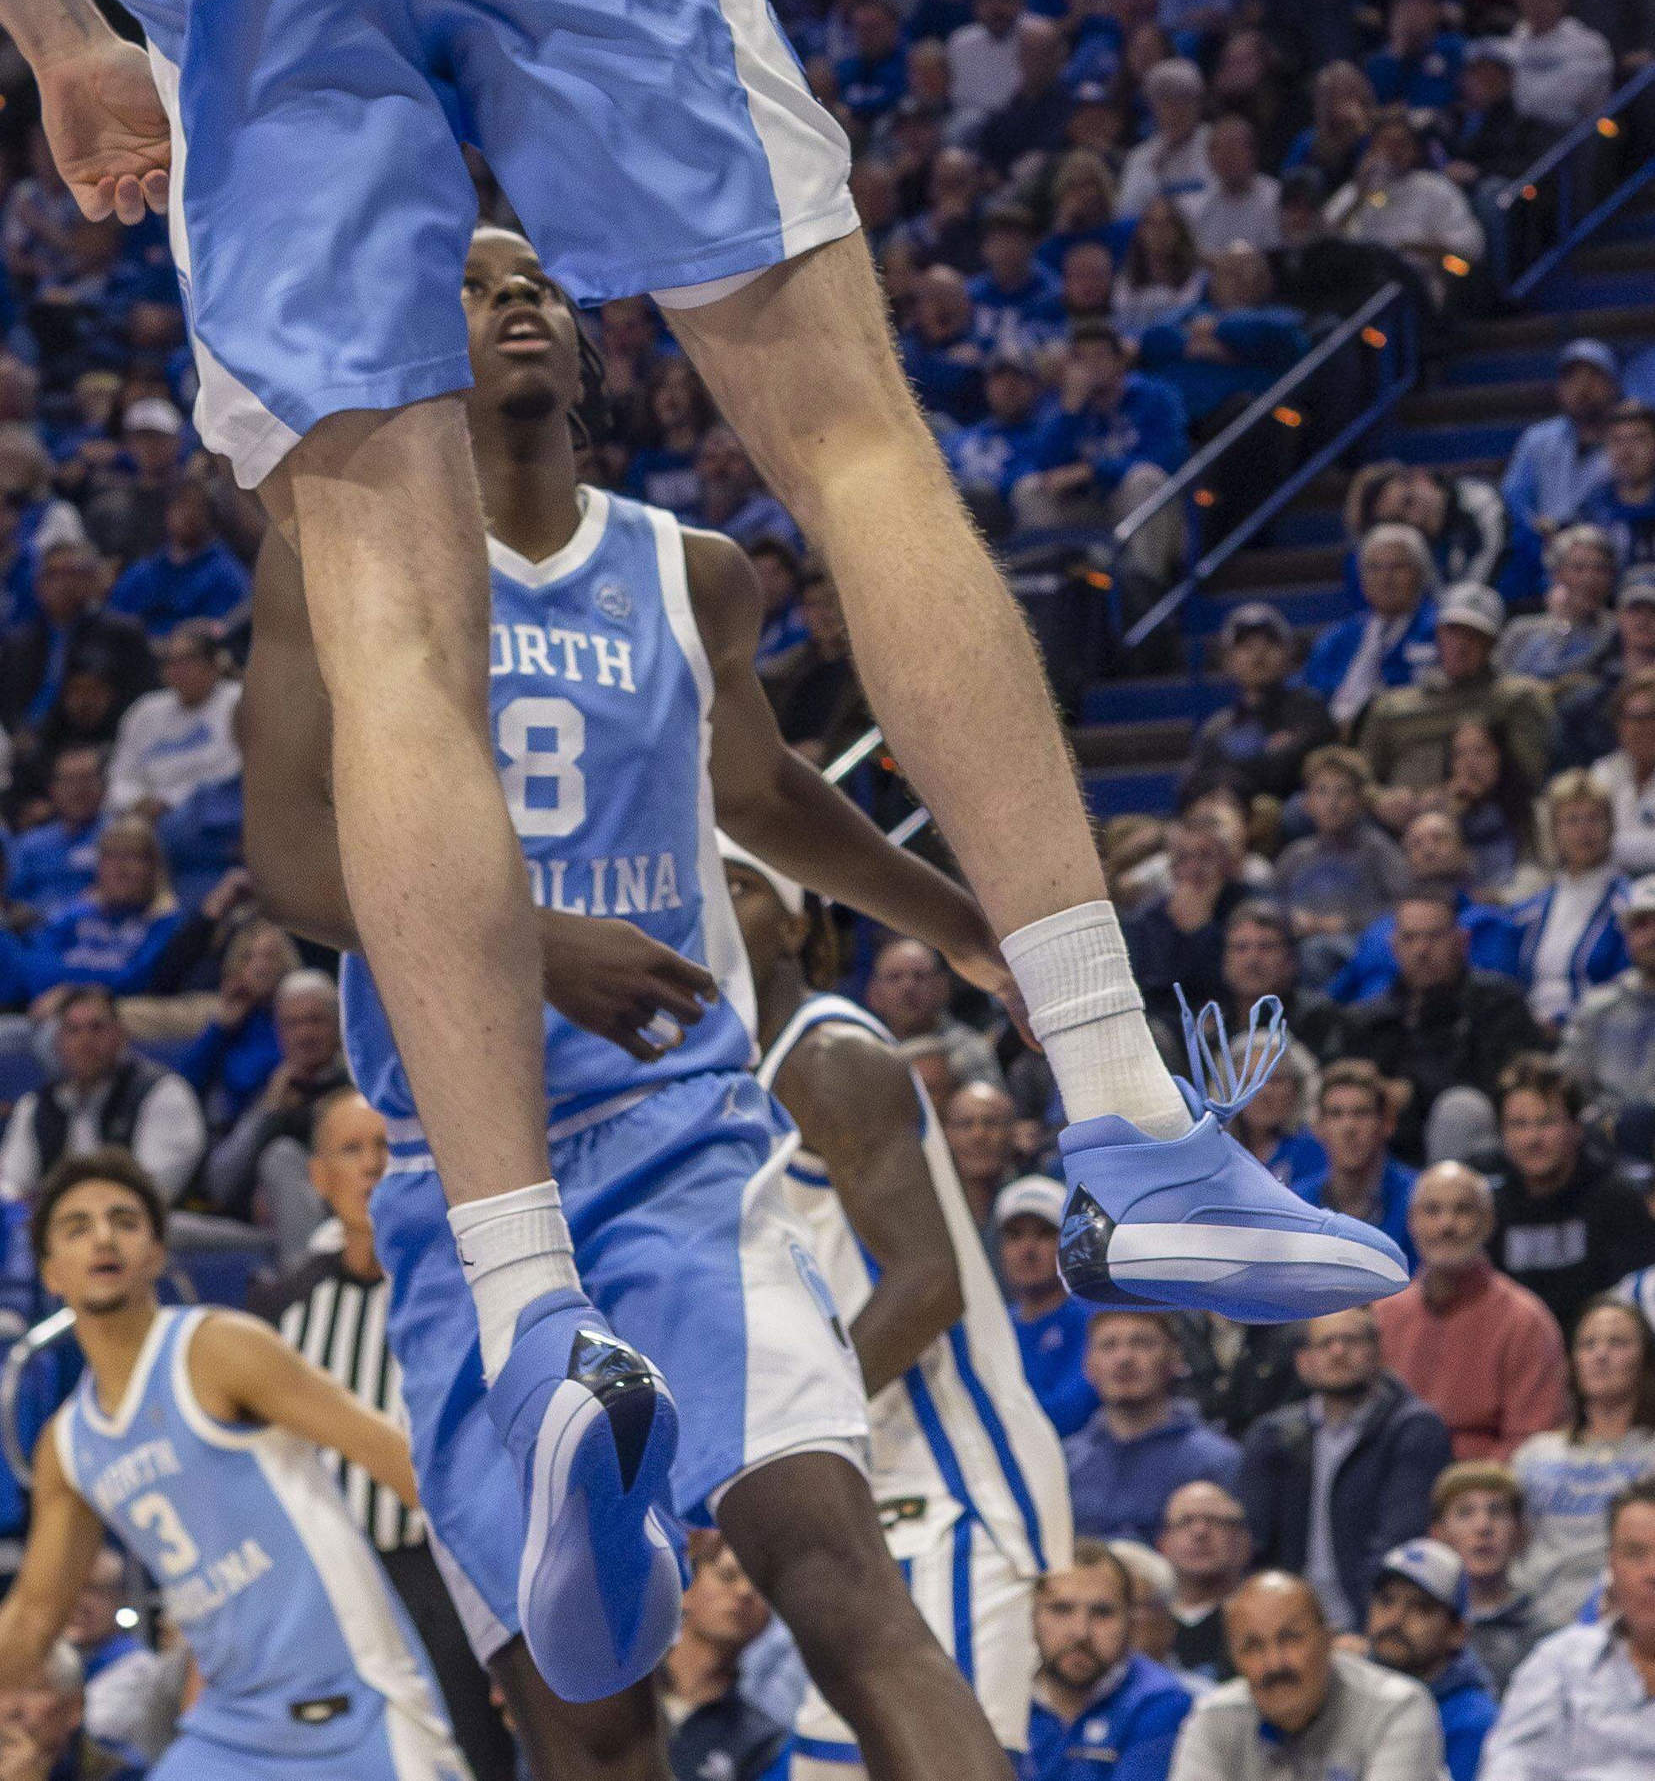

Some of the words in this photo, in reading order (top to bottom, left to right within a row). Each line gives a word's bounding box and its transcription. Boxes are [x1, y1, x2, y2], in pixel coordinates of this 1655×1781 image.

[489, 623, 637, 694] ORTH
[498, 696, 587, 838] 8
[527, 851, 684, 917] LINA
[129, 1492, 200, 1577] 3
